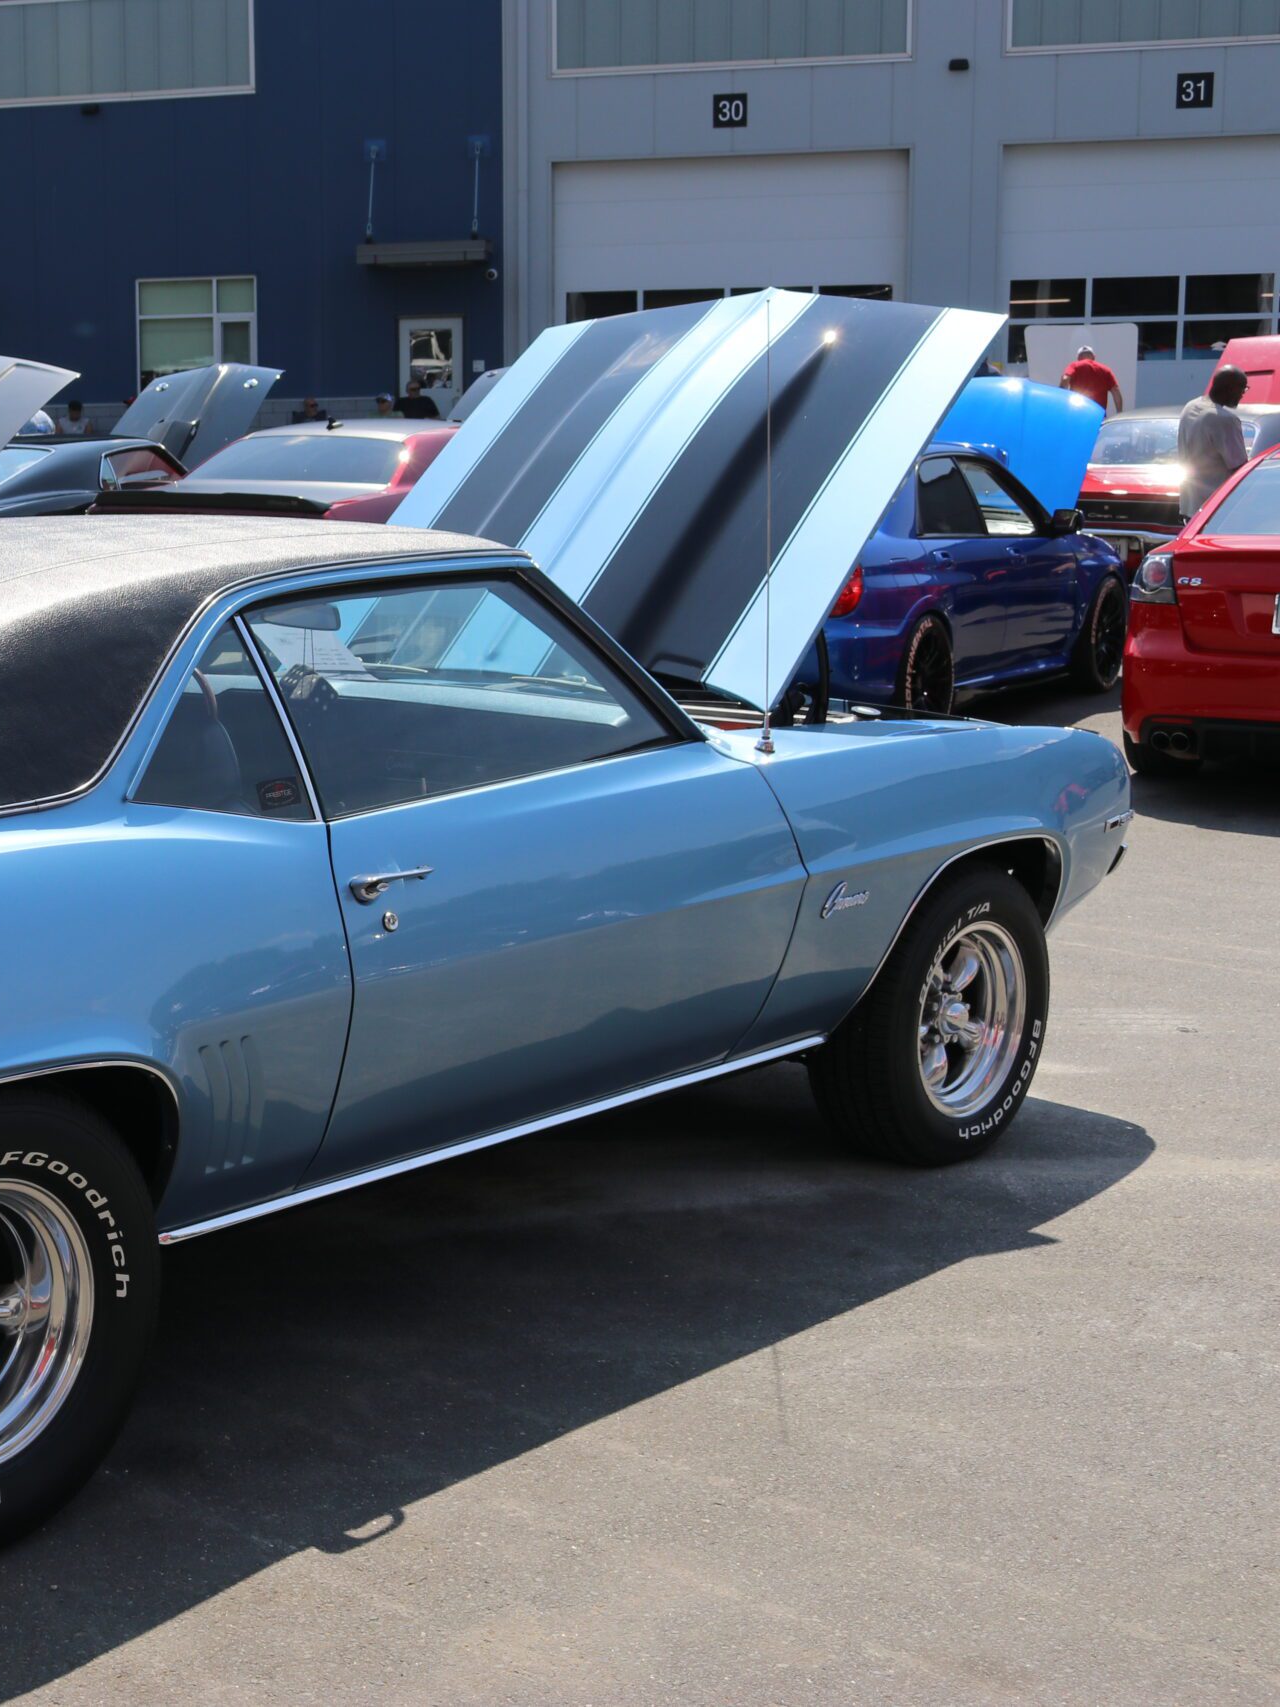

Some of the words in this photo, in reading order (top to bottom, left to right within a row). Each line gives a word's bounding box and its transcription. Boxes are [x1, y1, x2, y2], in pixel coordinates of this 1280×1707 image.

[1181, 80, 1206, 102] 31
[718, 100, 744, 122] 30
[1177, 576, 1202, 587] G8
[967, 902, 990, 920] T/A
[958, 1019, 1042, 1140] BFGoodrich
